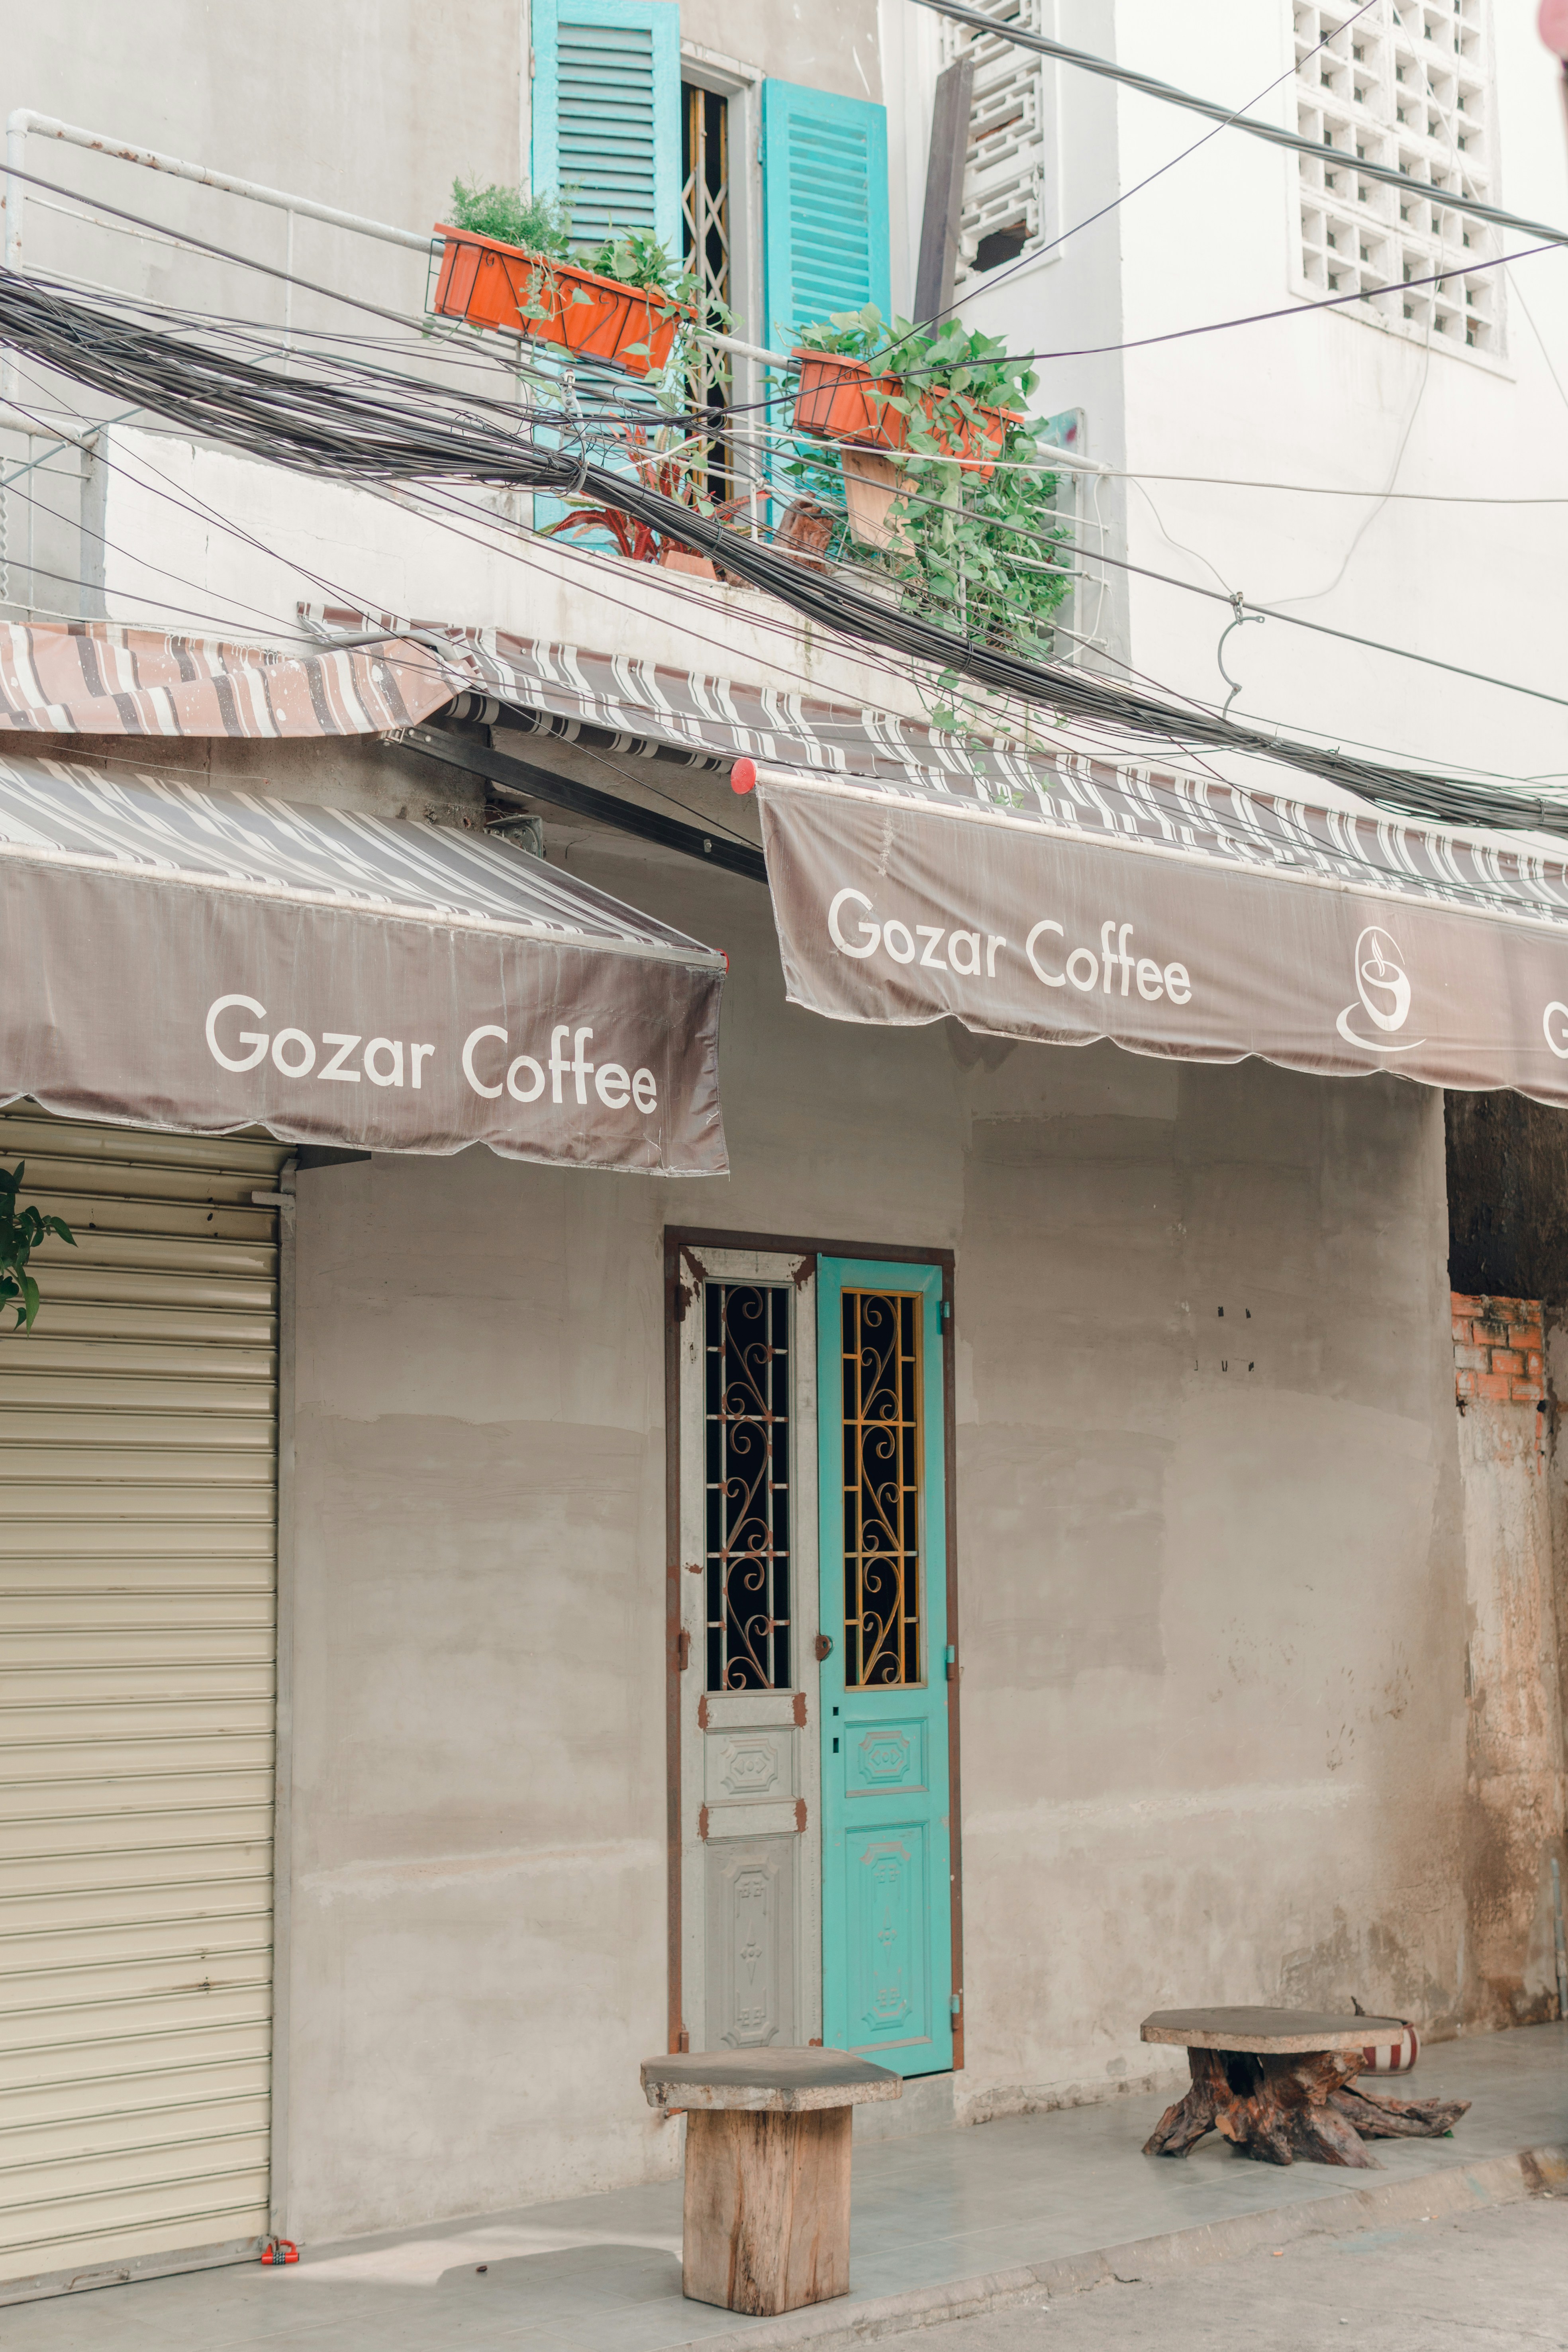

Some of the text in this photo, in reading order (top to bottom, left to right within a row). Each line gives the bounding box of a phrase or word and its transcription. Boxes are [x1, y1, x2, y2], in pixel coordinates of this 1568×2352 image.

[828, 887, 1192, 1005] Gozar Coffee
[205, 994, 657, 1114] Gozar Coffee
